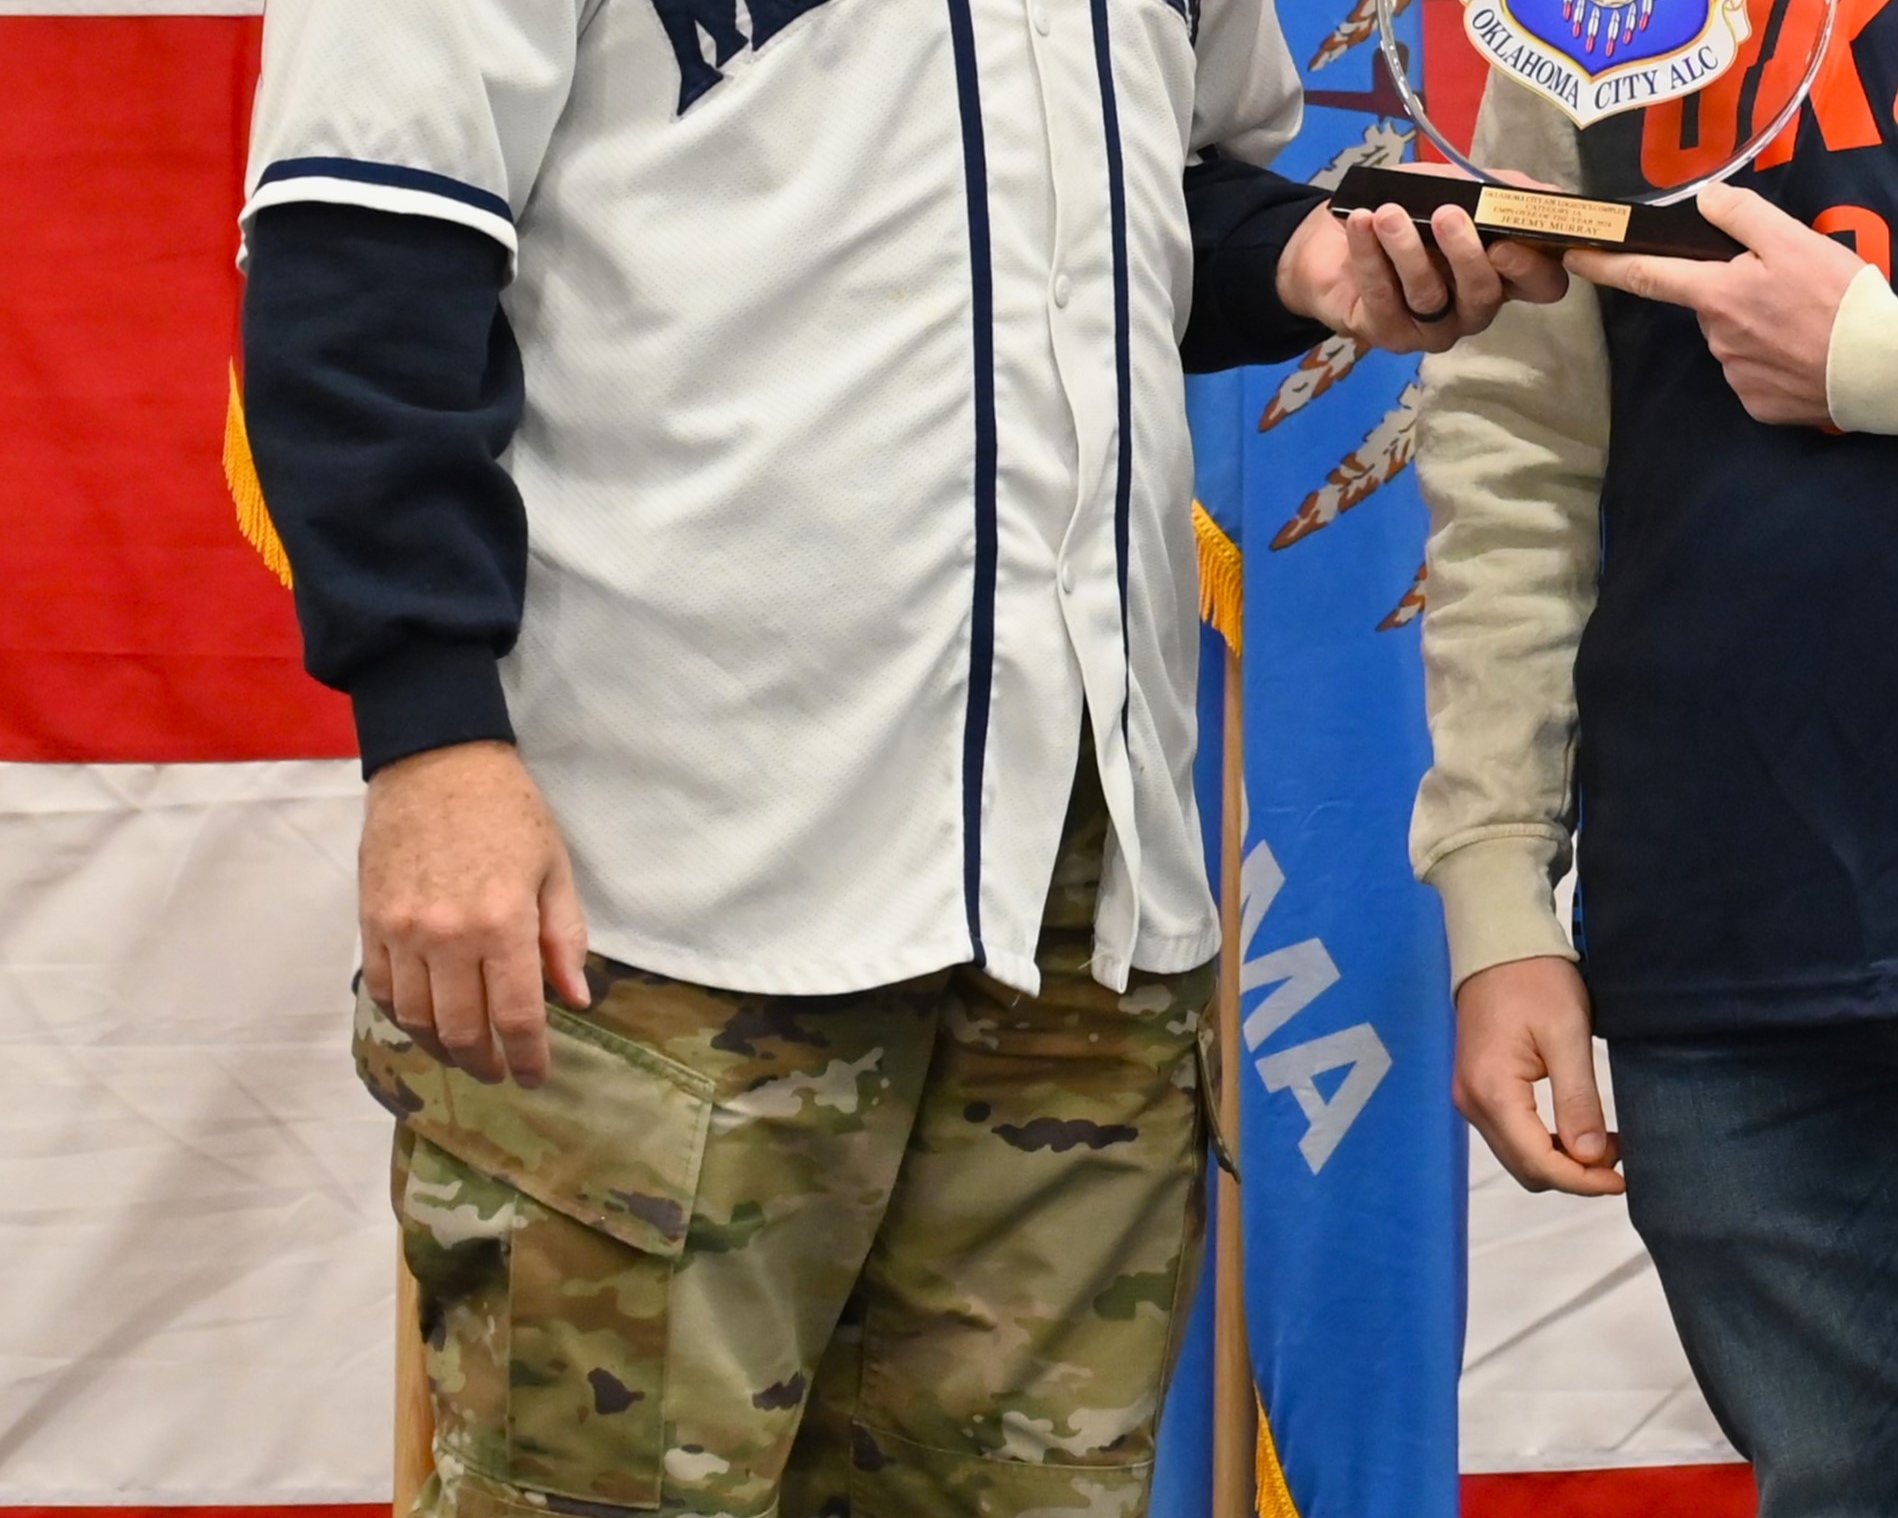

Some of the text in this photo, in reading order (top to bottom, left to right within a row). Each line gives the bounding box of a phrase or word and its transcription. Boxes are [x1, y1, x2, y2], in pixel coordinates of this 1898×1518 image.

[1471, 8, 1719, 110] OKLAHOMA CITY ALC
[1548, 221, 1599, 236] MURRAY
